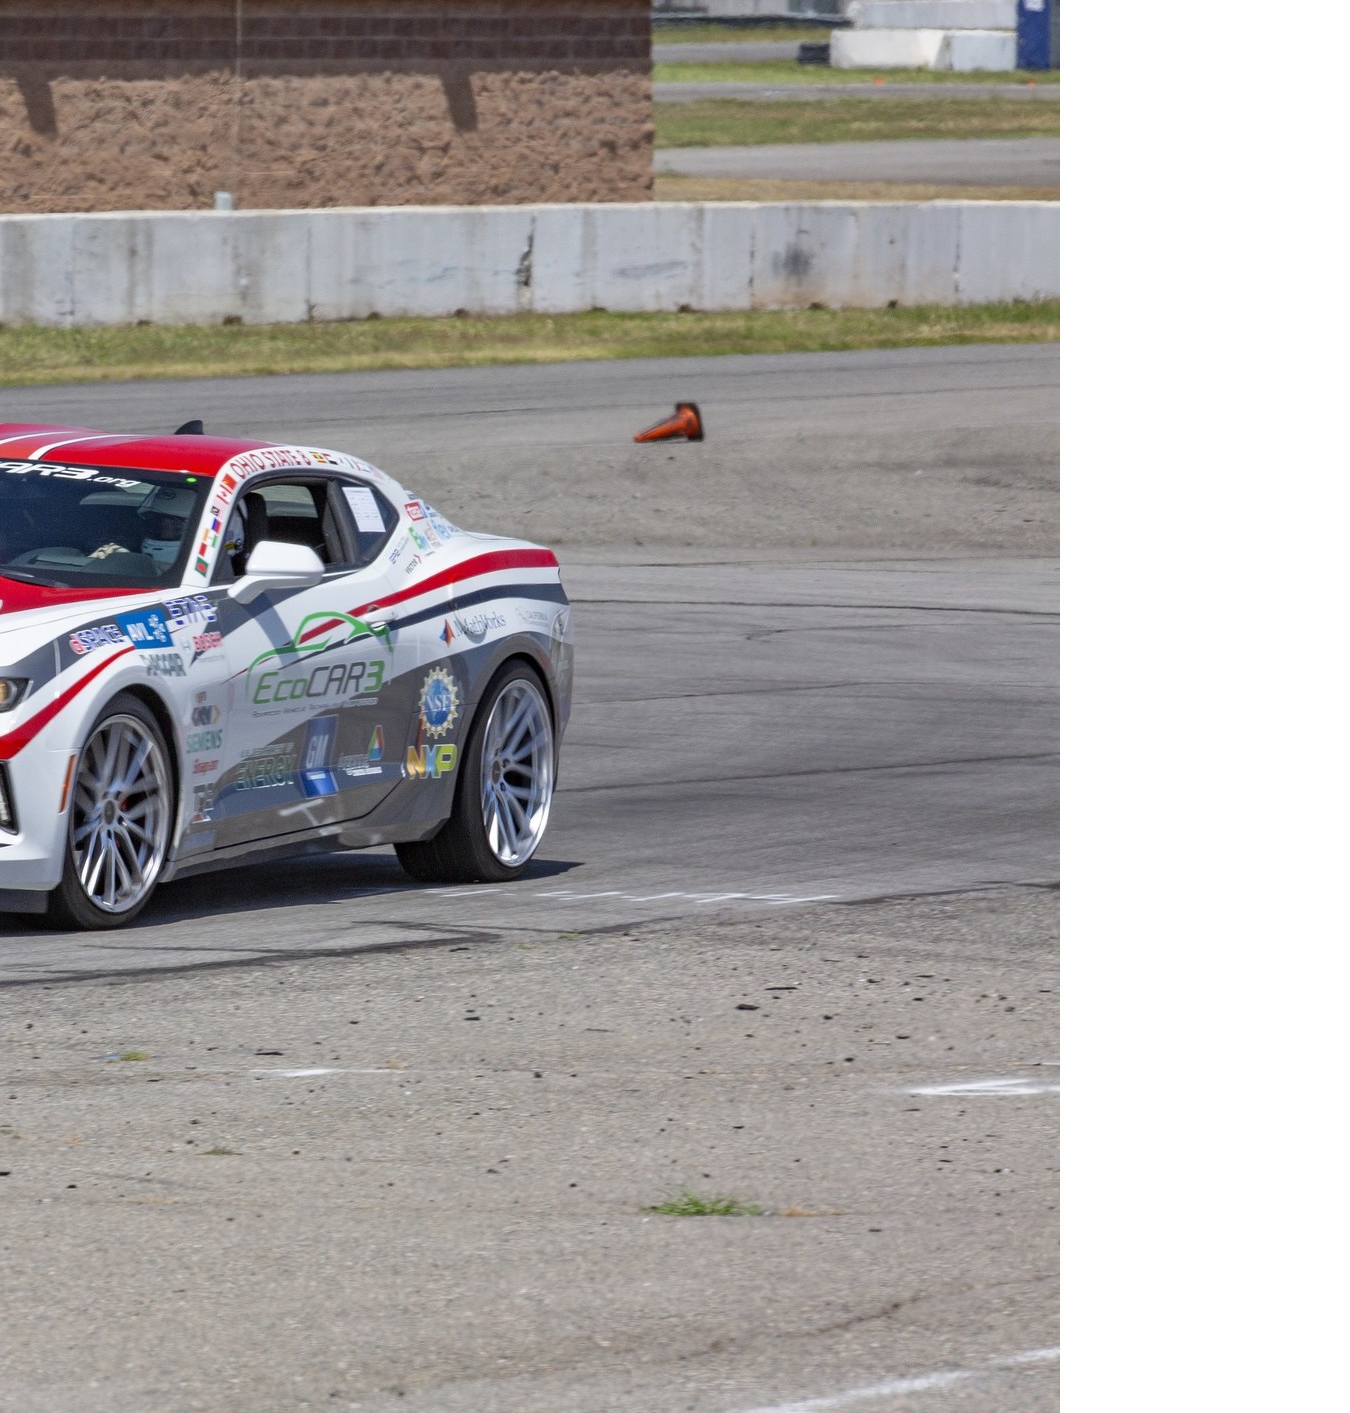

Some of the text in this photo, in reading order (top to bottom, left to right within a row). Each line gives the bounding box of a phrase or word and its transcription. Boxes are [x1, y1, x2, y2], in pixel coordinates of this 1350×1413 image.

[230, 454, 266, 479] OHIO
[260, 450, 302, 468] STATE
[126, 622, 153, 642] AVL
[252, 660, 385, 704] EcoCAR3
[425, 694, 451, 713] NSF
[305, 734, 329, 769] GM
[407, 744, 458, 780] NXP
